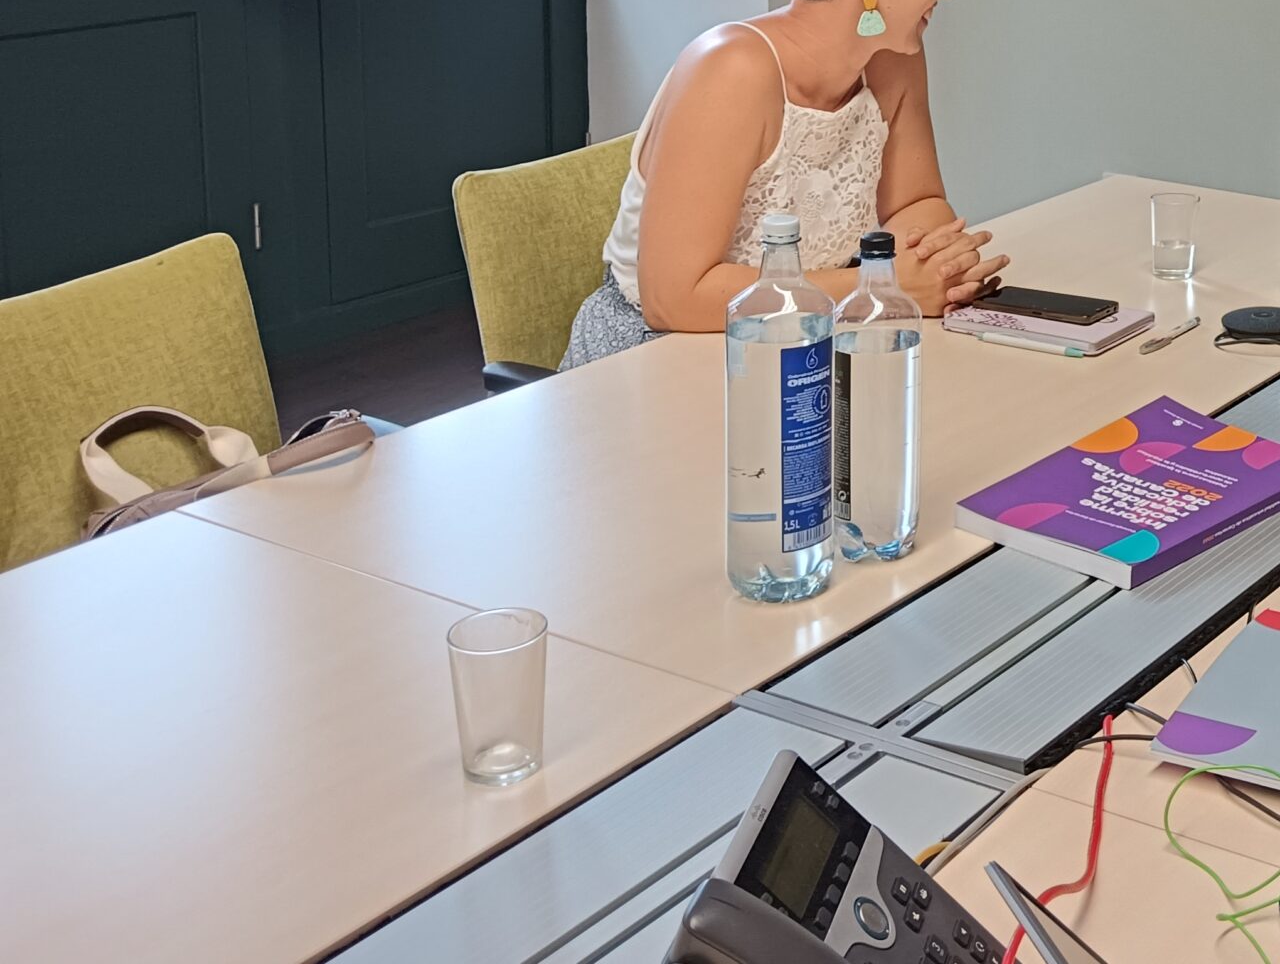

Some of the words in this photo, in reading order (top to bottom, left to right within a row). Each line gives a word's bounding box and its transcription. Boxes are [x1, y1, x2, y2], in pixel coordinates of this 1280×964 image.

[1079, 456, 1181, 498] Canarias
[1091, 471, 1201, 512] educativa
[1163, 478, 1224, 502] 2022
[1089, 490, 1113, 504] la
[1092, 484, 1191, 518] realidad
[1108, 497, 1180, 524] sobre
[1177, 492, 1213, 508] de
[1078, 498, 1168, 531] Informe
